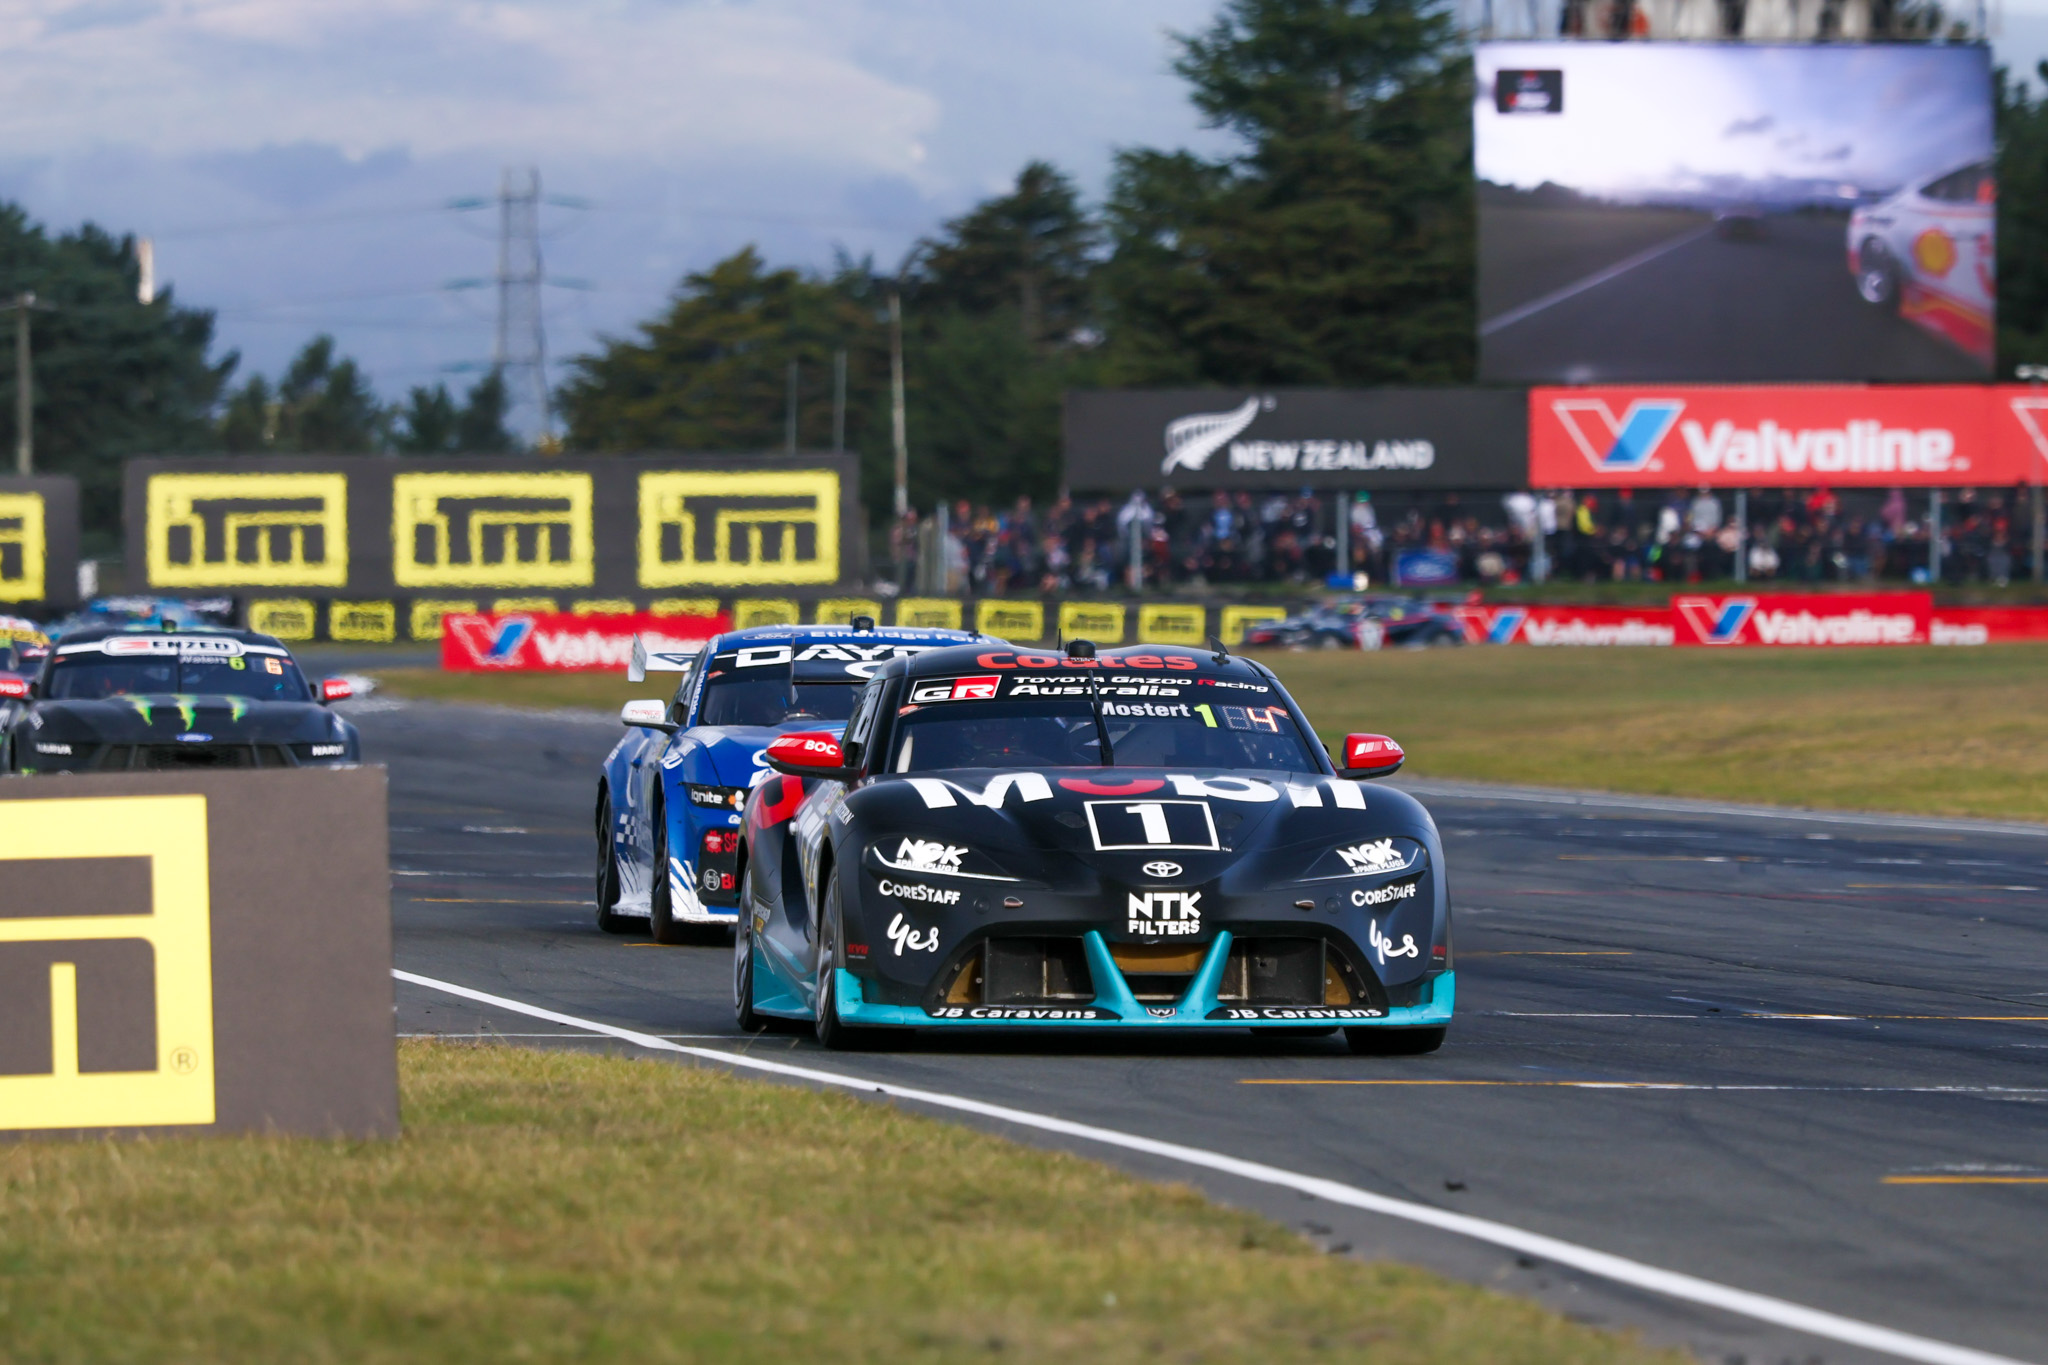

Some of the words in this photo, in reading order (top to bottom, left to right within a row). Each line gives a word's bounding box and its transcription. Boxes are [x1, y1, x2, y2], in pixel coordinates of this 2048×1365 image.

[1229, 439, 1298, 471] NEW
[1300, 439, 1435, 471] ZEALAND
[1680, 420, 1955, 473] Valvoline
[1753, 609, 1916, 644] Valvoline
[152, 640, 230, 651] ENZED
[180, 655, 229, 665] Waters
[228, 656, 246, 671] 6
[976, 652, 1198, 670] Coates
[913, 683, 995, 701] GR
[1008, 684, 1180, 697] Australia
[1013, 676, 1104, 684] TOYOTA
[1111, 676, 1193, 685] GAZOO
[1197, 678, 1269, 693] Racing
[1092, 701, 1192, 718] Mostert
[1193, 703, 1219, 729] 1
[804, 739, 838, 756] BOC
[691, 787, 723, 805] ignite
[904, 772, 1367, 809] Mobil
[1125, 803, 1172, 844] 1
[896, 836, 969, 866] NGK
[1336, 838, 1402, 868] NGK
[927, 863, 960, 873] PLUGS
[1351, 863, 1382, 874] SPARK
[1381, 858, 1406, 870] PLUGS
[1128, 891, 1202, 920] NTK
[1128, 919, 1201, 936] FILTERS
[931, 1007, 965, 1018] JB
[970, 1007, 1097, 1019] Caravans
[1227, 1008, 1259, 1020] JB
[1264, 1006, 1383, 1019] Caravans
